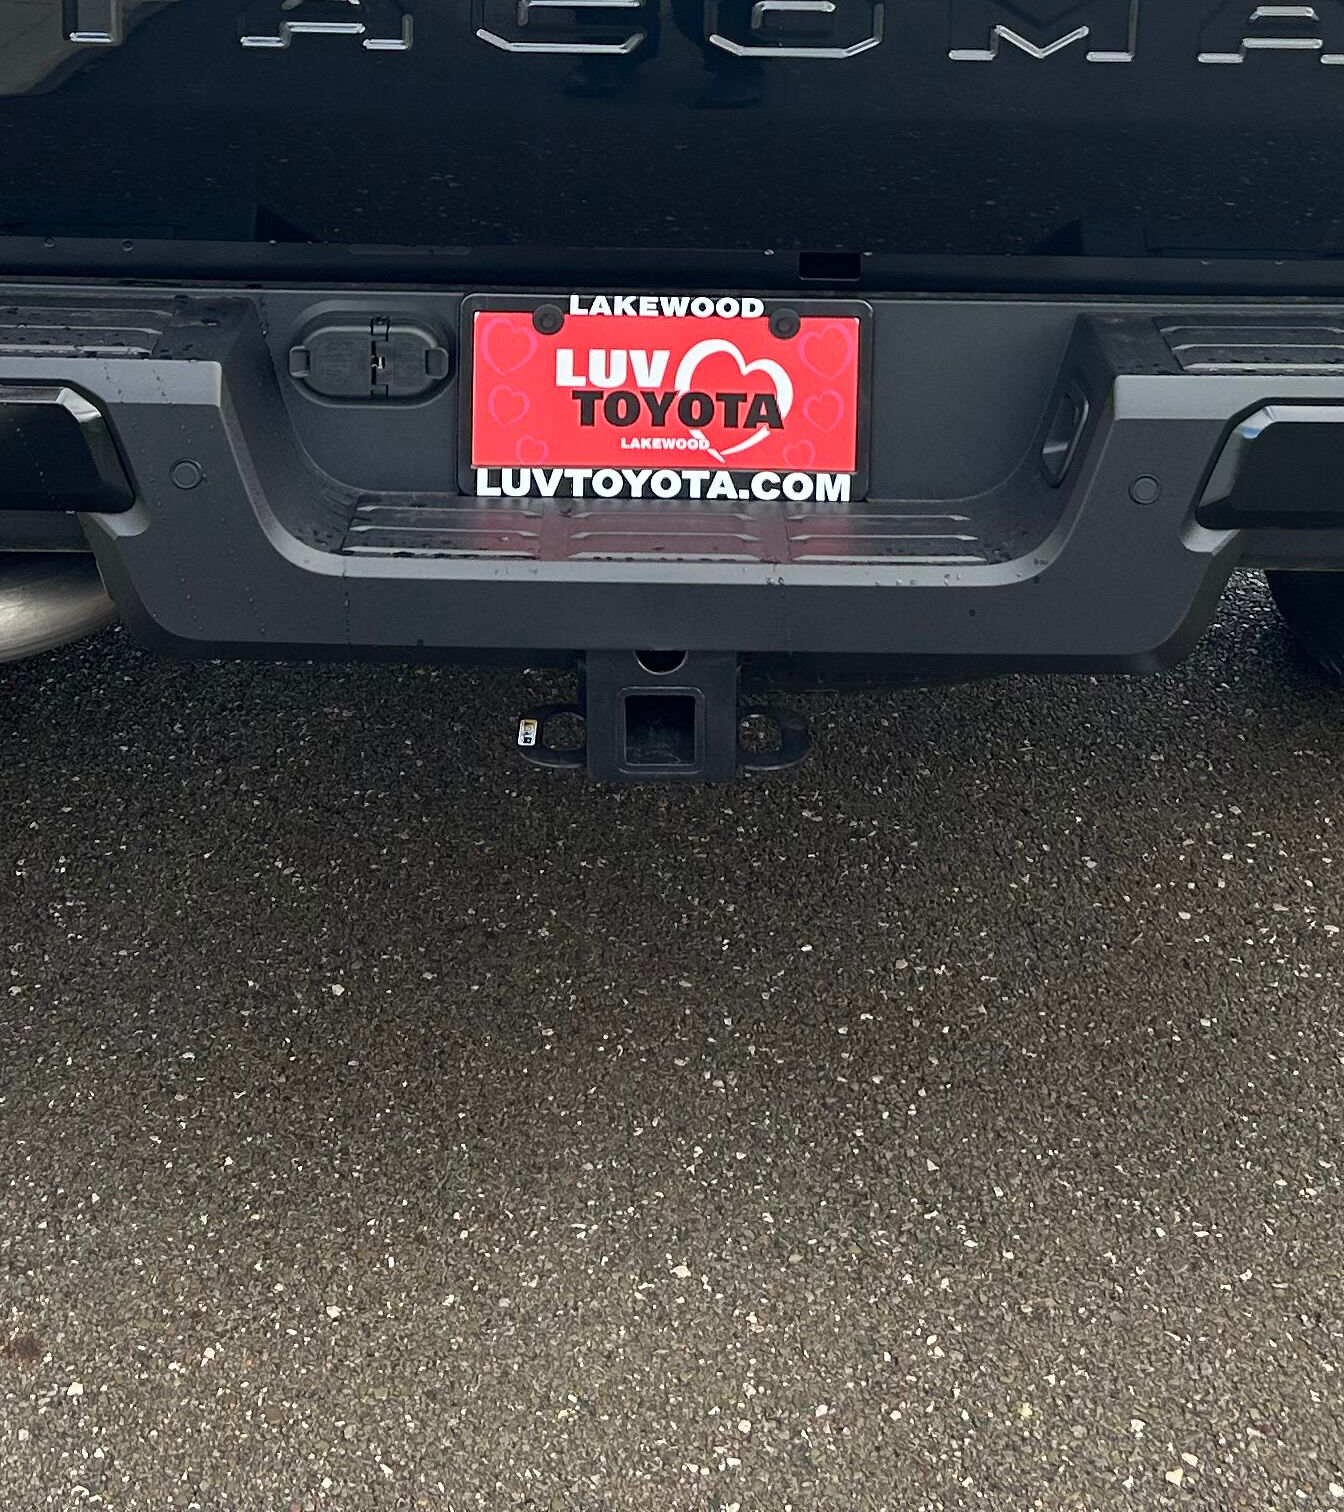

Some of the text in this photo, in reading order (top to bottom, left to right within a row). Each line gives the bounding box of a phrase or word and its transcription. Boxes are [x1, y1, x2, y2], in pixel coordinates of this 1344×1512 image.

[569, 294, 765, 319] LAKEWOOD
[556, 348, 671, 388] LUV
[572, 390, 784, 429] TOYOTA
[620, 437, 711, 452] LAKEWOOD
[476, 467, 851, 503] LUVTOYOTA.COM
